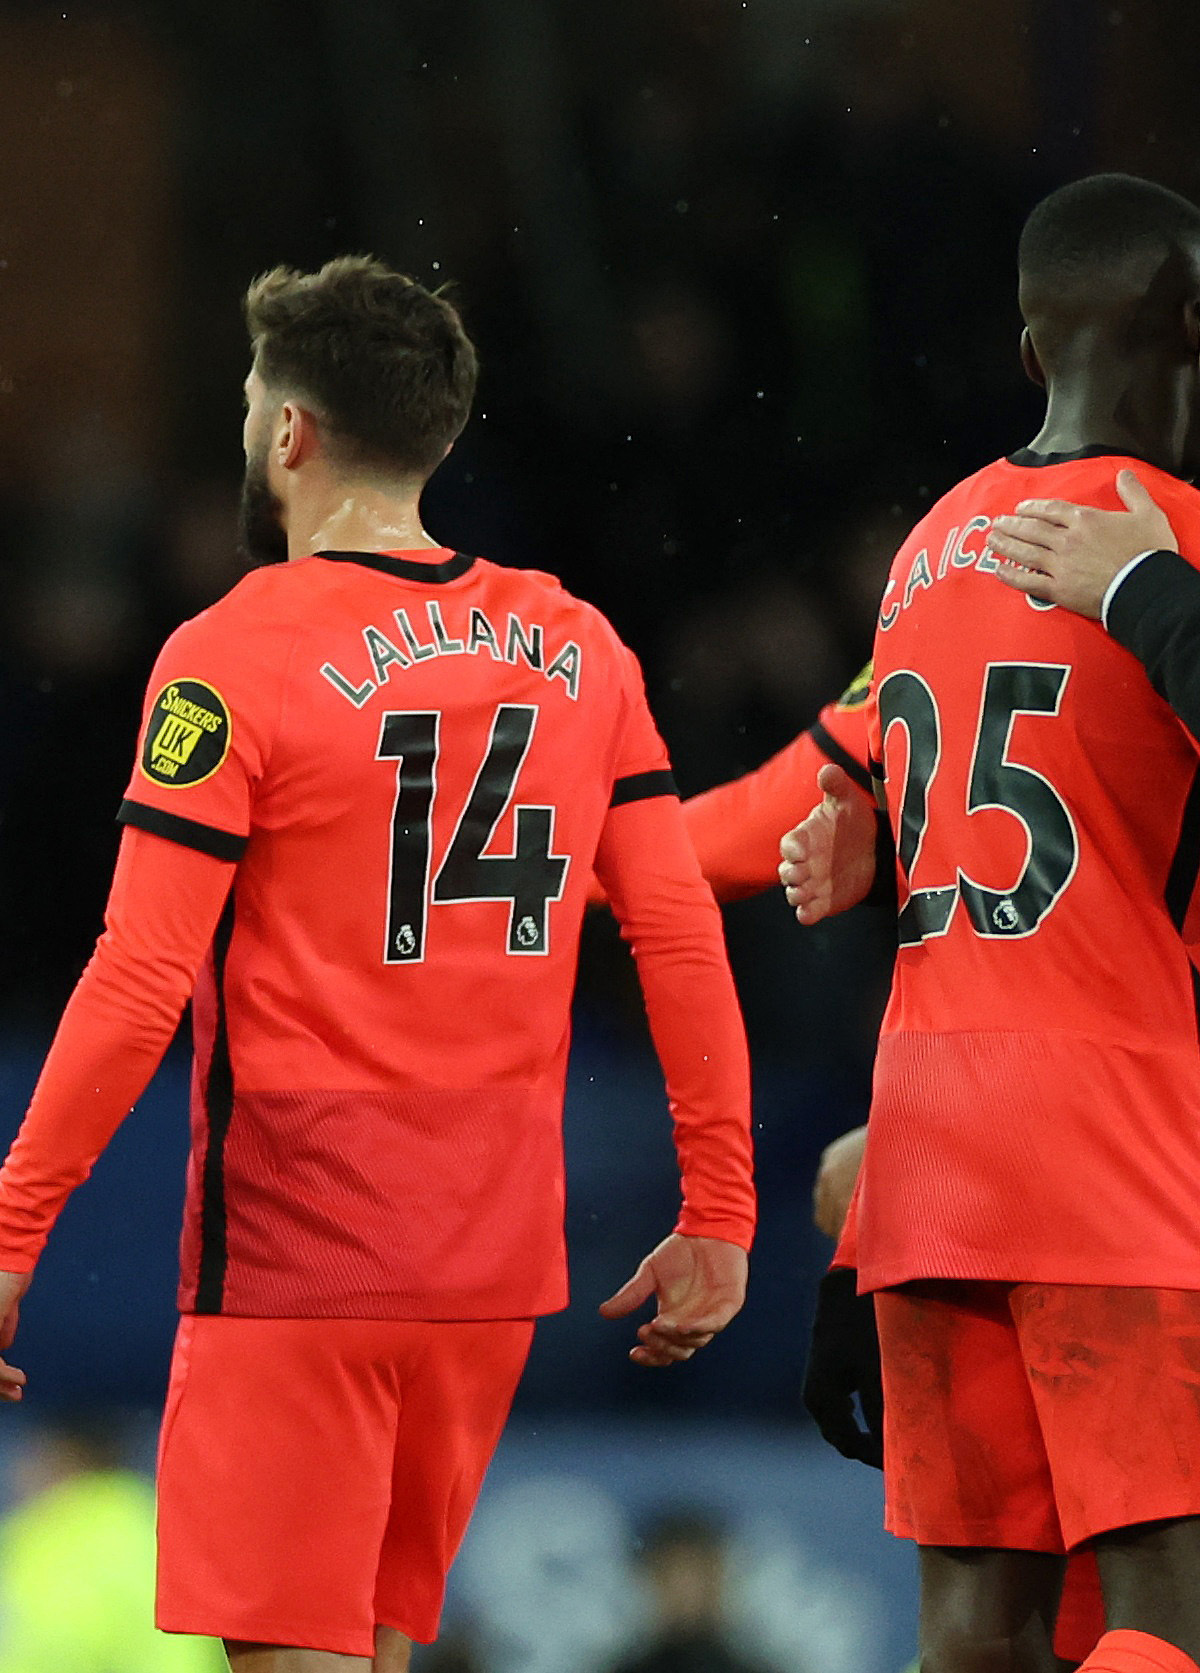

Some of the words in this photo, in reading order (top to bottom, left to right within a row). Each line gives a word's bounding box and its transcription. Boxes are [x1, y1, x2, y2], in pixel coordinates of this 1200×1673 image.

[878, 515, 1058, 632] CAICE
[320, 601, 581, 708] LALLANA
[159, 720, 195, 757] UK
[375, 704, 571, 965] 14
[876, 662, 1080, 949] 25
